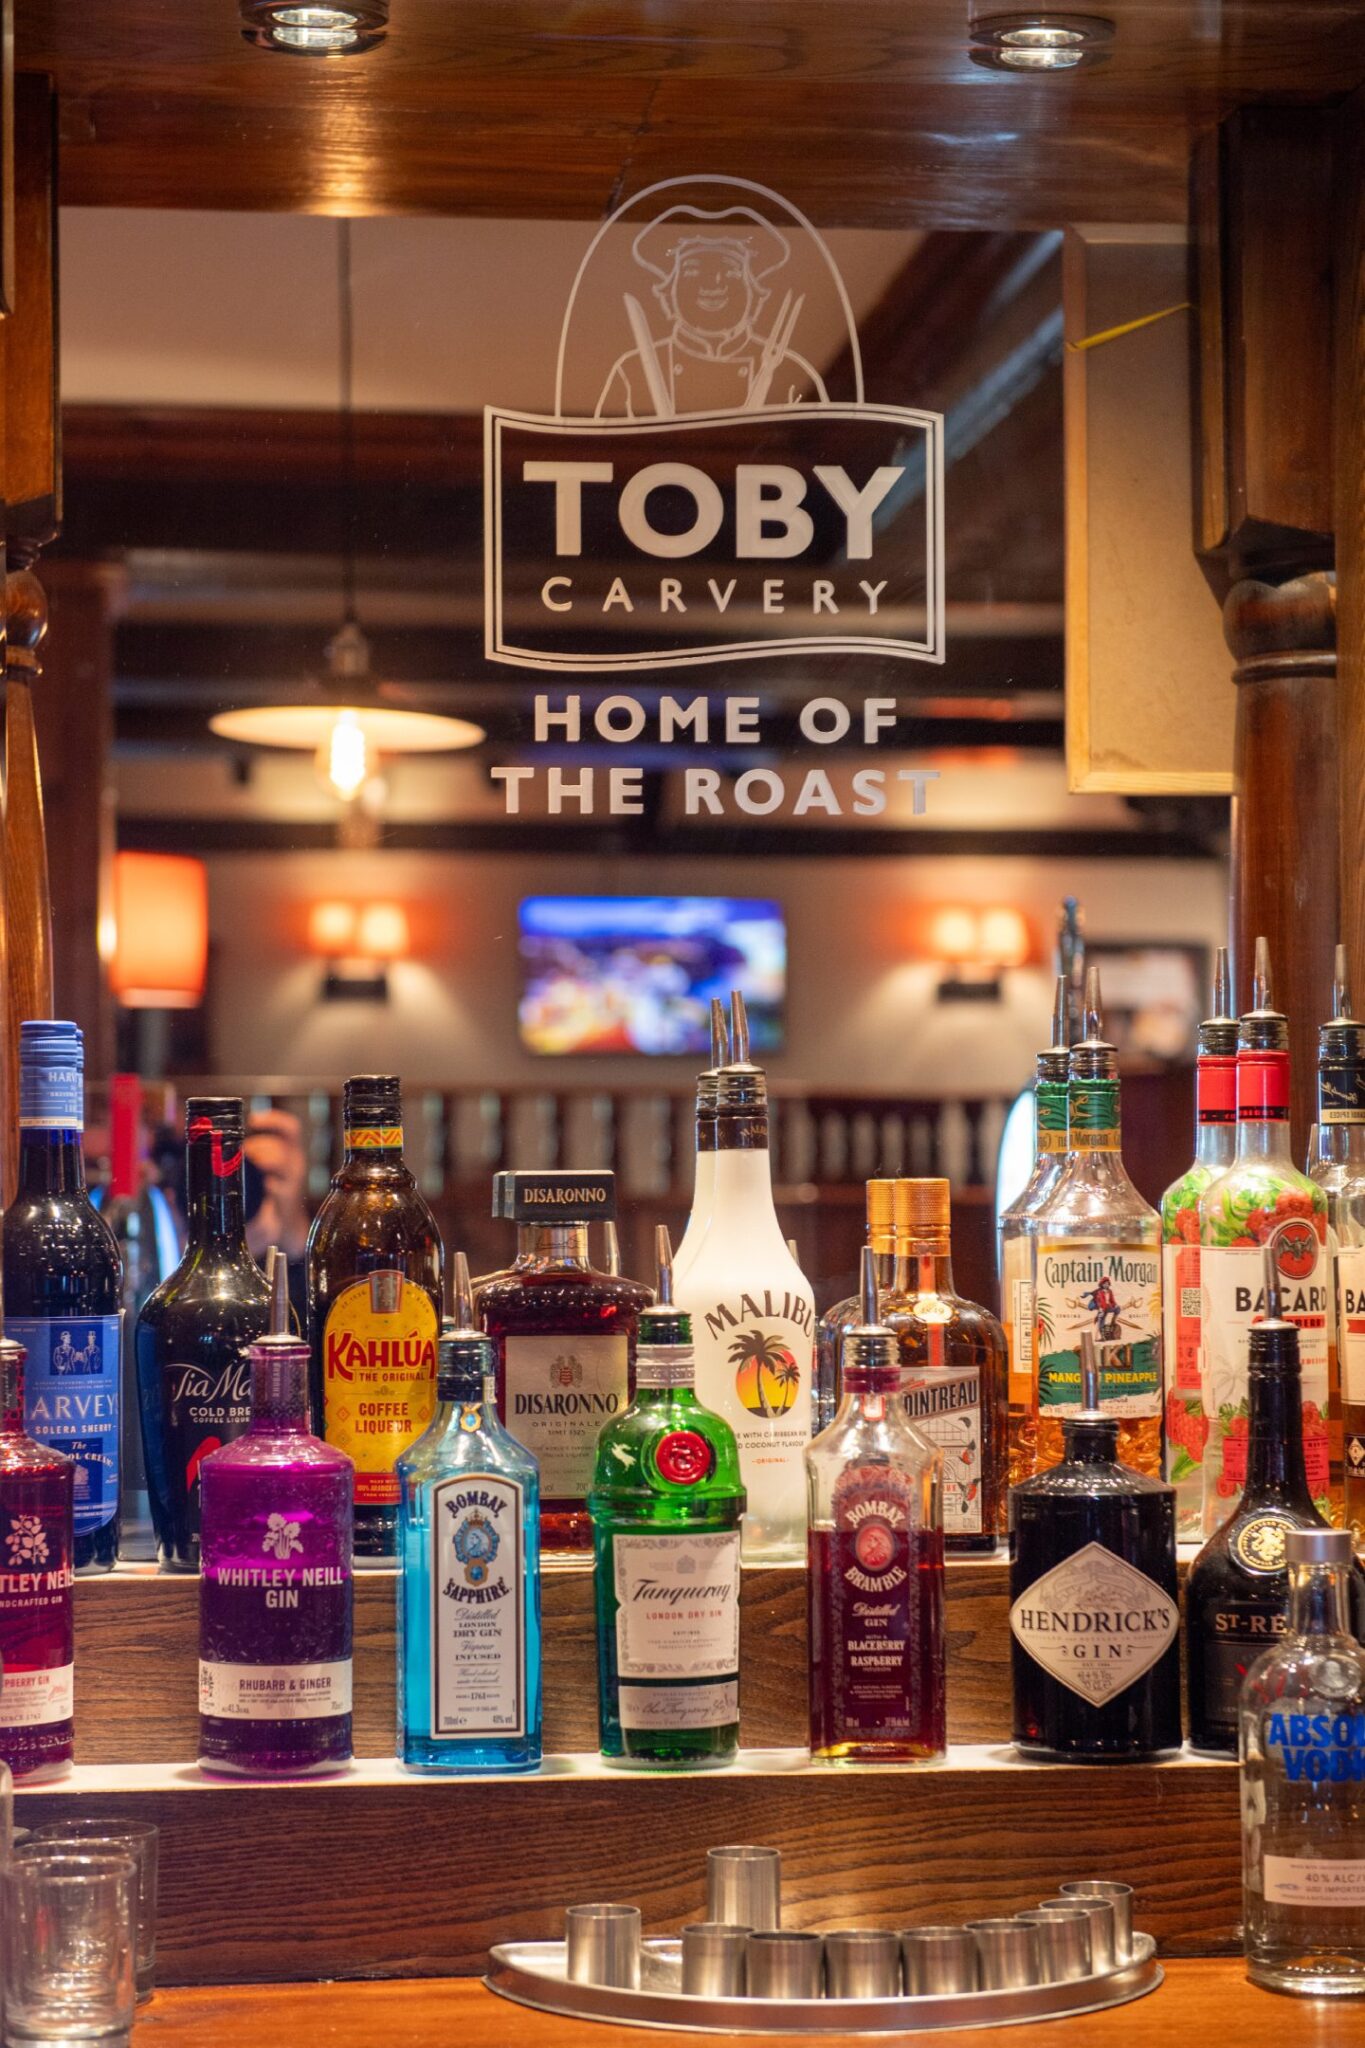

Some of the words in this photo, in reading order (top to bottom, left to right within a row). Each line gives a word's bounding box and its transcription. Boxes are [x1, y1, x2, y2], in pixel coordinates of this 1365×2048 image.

[523, 461, 906, 559] TOBY
[541, 576, 888, 615] CARVERY
[534, 695, 761, 743] HOME
[800, 697, 897, 744] OF
[491, 767, 644, 814] THE
[685, 768, 941, 816] ROAST
[524, 1188, 606, 1204] DISARONNO
[1045, 1255, 1103, 1288] Captain
[1105, 1255, 1158, 1288] Morgan
[704, 1290, 812, 1341] MALIBU
[327, 1330, 436, 1381] KAHLÚA
[360, 1372, 378, 1382] THE
[382, 1372, 425, 1382] ORIGINAL
[1049, 1372, 1083, 1383] MANG
[1104, 1371, 1157, 1384] PINEAPPLE
[189, 1406, 225, 1417] COLD
[359, 1402, 408, 1416] COFFEE
[514, 1393, 619, 1416] DISARONNO
[35, 1425, 77, 1434] SOLERA
[355, 1419, 412, 1434] LIQUEUR
[445, 1491, 508, 1519] BOMBAY
[845, 1500, 905, 1529] BOMBAY
[217, 1567, 297, 1587] WHITLEY
[302, 1566, 344, 1586] NEILL
[844, 1566, 908, 1593] BRAMBLE
[265, 1589, 299, 1608] GIN
[442, 1576, 510, 1604] SAPPHIRE
[633, 1579, 731, 1605] Tanqueray
[646, 1612, 684, 1620] LONDON
[688, 1610, 705, 1619] DRY
[864, 1618, 888, 1627] GIN
[1020, 1607, 1170, 1633] HENDRICK'S
[453, 1629, 477, 1638] DRY
[479, 1628, 502, 1637] GIN
[847, 1640, 906, 1651] BLACKBERRY
[1074, 1644, 1122, 1658] GIN
[850, 1655, 903, 1667] RASPBERRY
[239, 1679, 286, 1691] RHUBARB
[289, 1679, 297, 1691] &
[300, 1676, 332, 1690] GINGER
